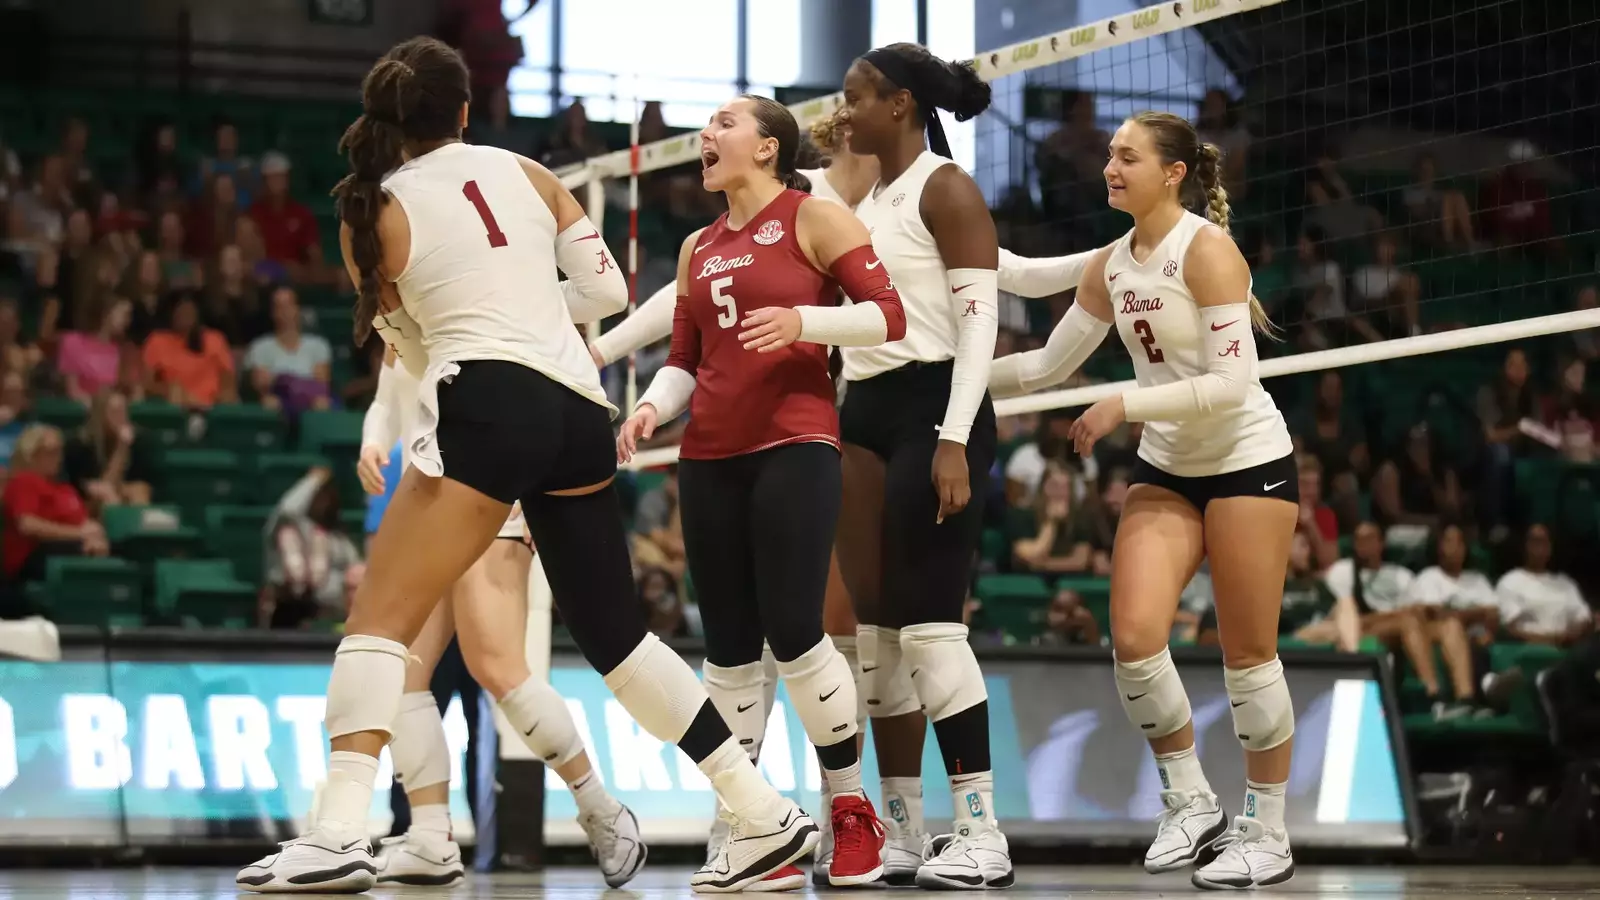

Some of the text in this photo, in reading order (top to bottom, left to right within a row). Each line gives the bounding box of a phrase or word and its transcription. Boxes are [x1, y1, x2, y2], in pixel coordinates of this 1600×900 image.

[1133, 10, 1160, 30] UAB
[1070, 27, 1096, 47] UAB
[462, 180, 508, 248] 1
[759, 221, 782, 238] SEC
[595, 249, 614, 274] A
[697, 253, 754, 279] Bama
[710, 276, 738, 329] 5
[961, 300, 979, 317] A
[1120, 290, 1163, 314] Bama
[1133, 319, 1165, 364] 2
[1218, 339, 1241, 357] A
[61, 693, 467, 790] BART
